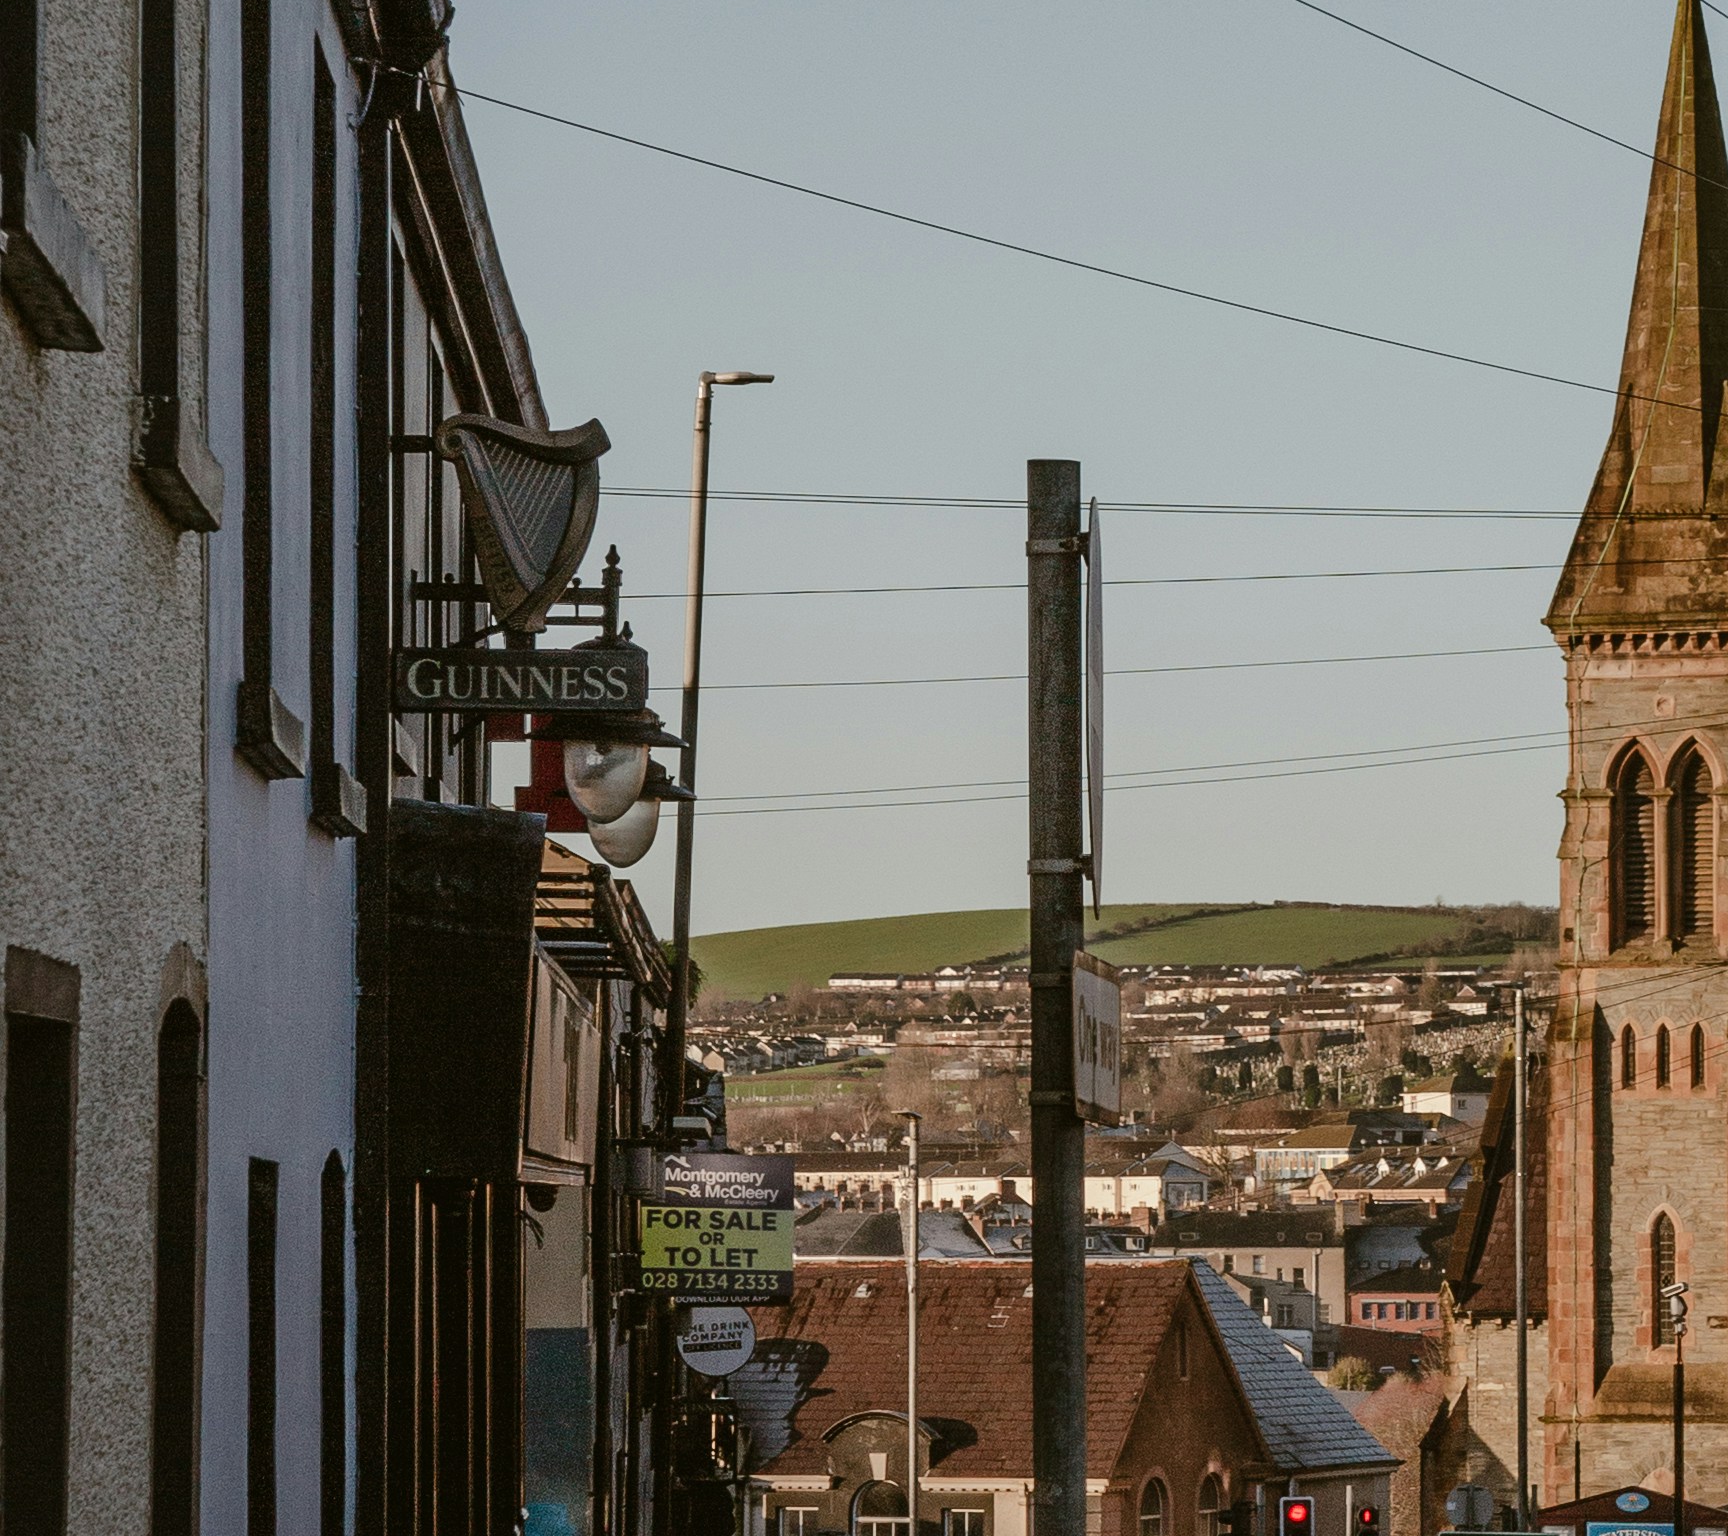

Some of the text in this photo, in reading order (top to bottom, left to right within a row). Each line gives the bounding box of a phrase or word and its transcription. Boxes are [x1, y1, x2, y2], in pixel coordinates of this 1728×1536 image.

[407, 658, 628, 700] GUINNESS
[665, 1167, 765, 1186] Montgomery
[690, 1184, 779, 1202] & McCleery
[646, 1210, 777, 1231] FOR SALE
[699, 1232, 725, 1245] OR
[664, 1247, 758, 1267] TO LET
[642, 1272, 779, 1290] 028 7134 2333
[711, 1321, 750, 1331] DRINK
[682, 1331, 743, 1342] COMPANY
